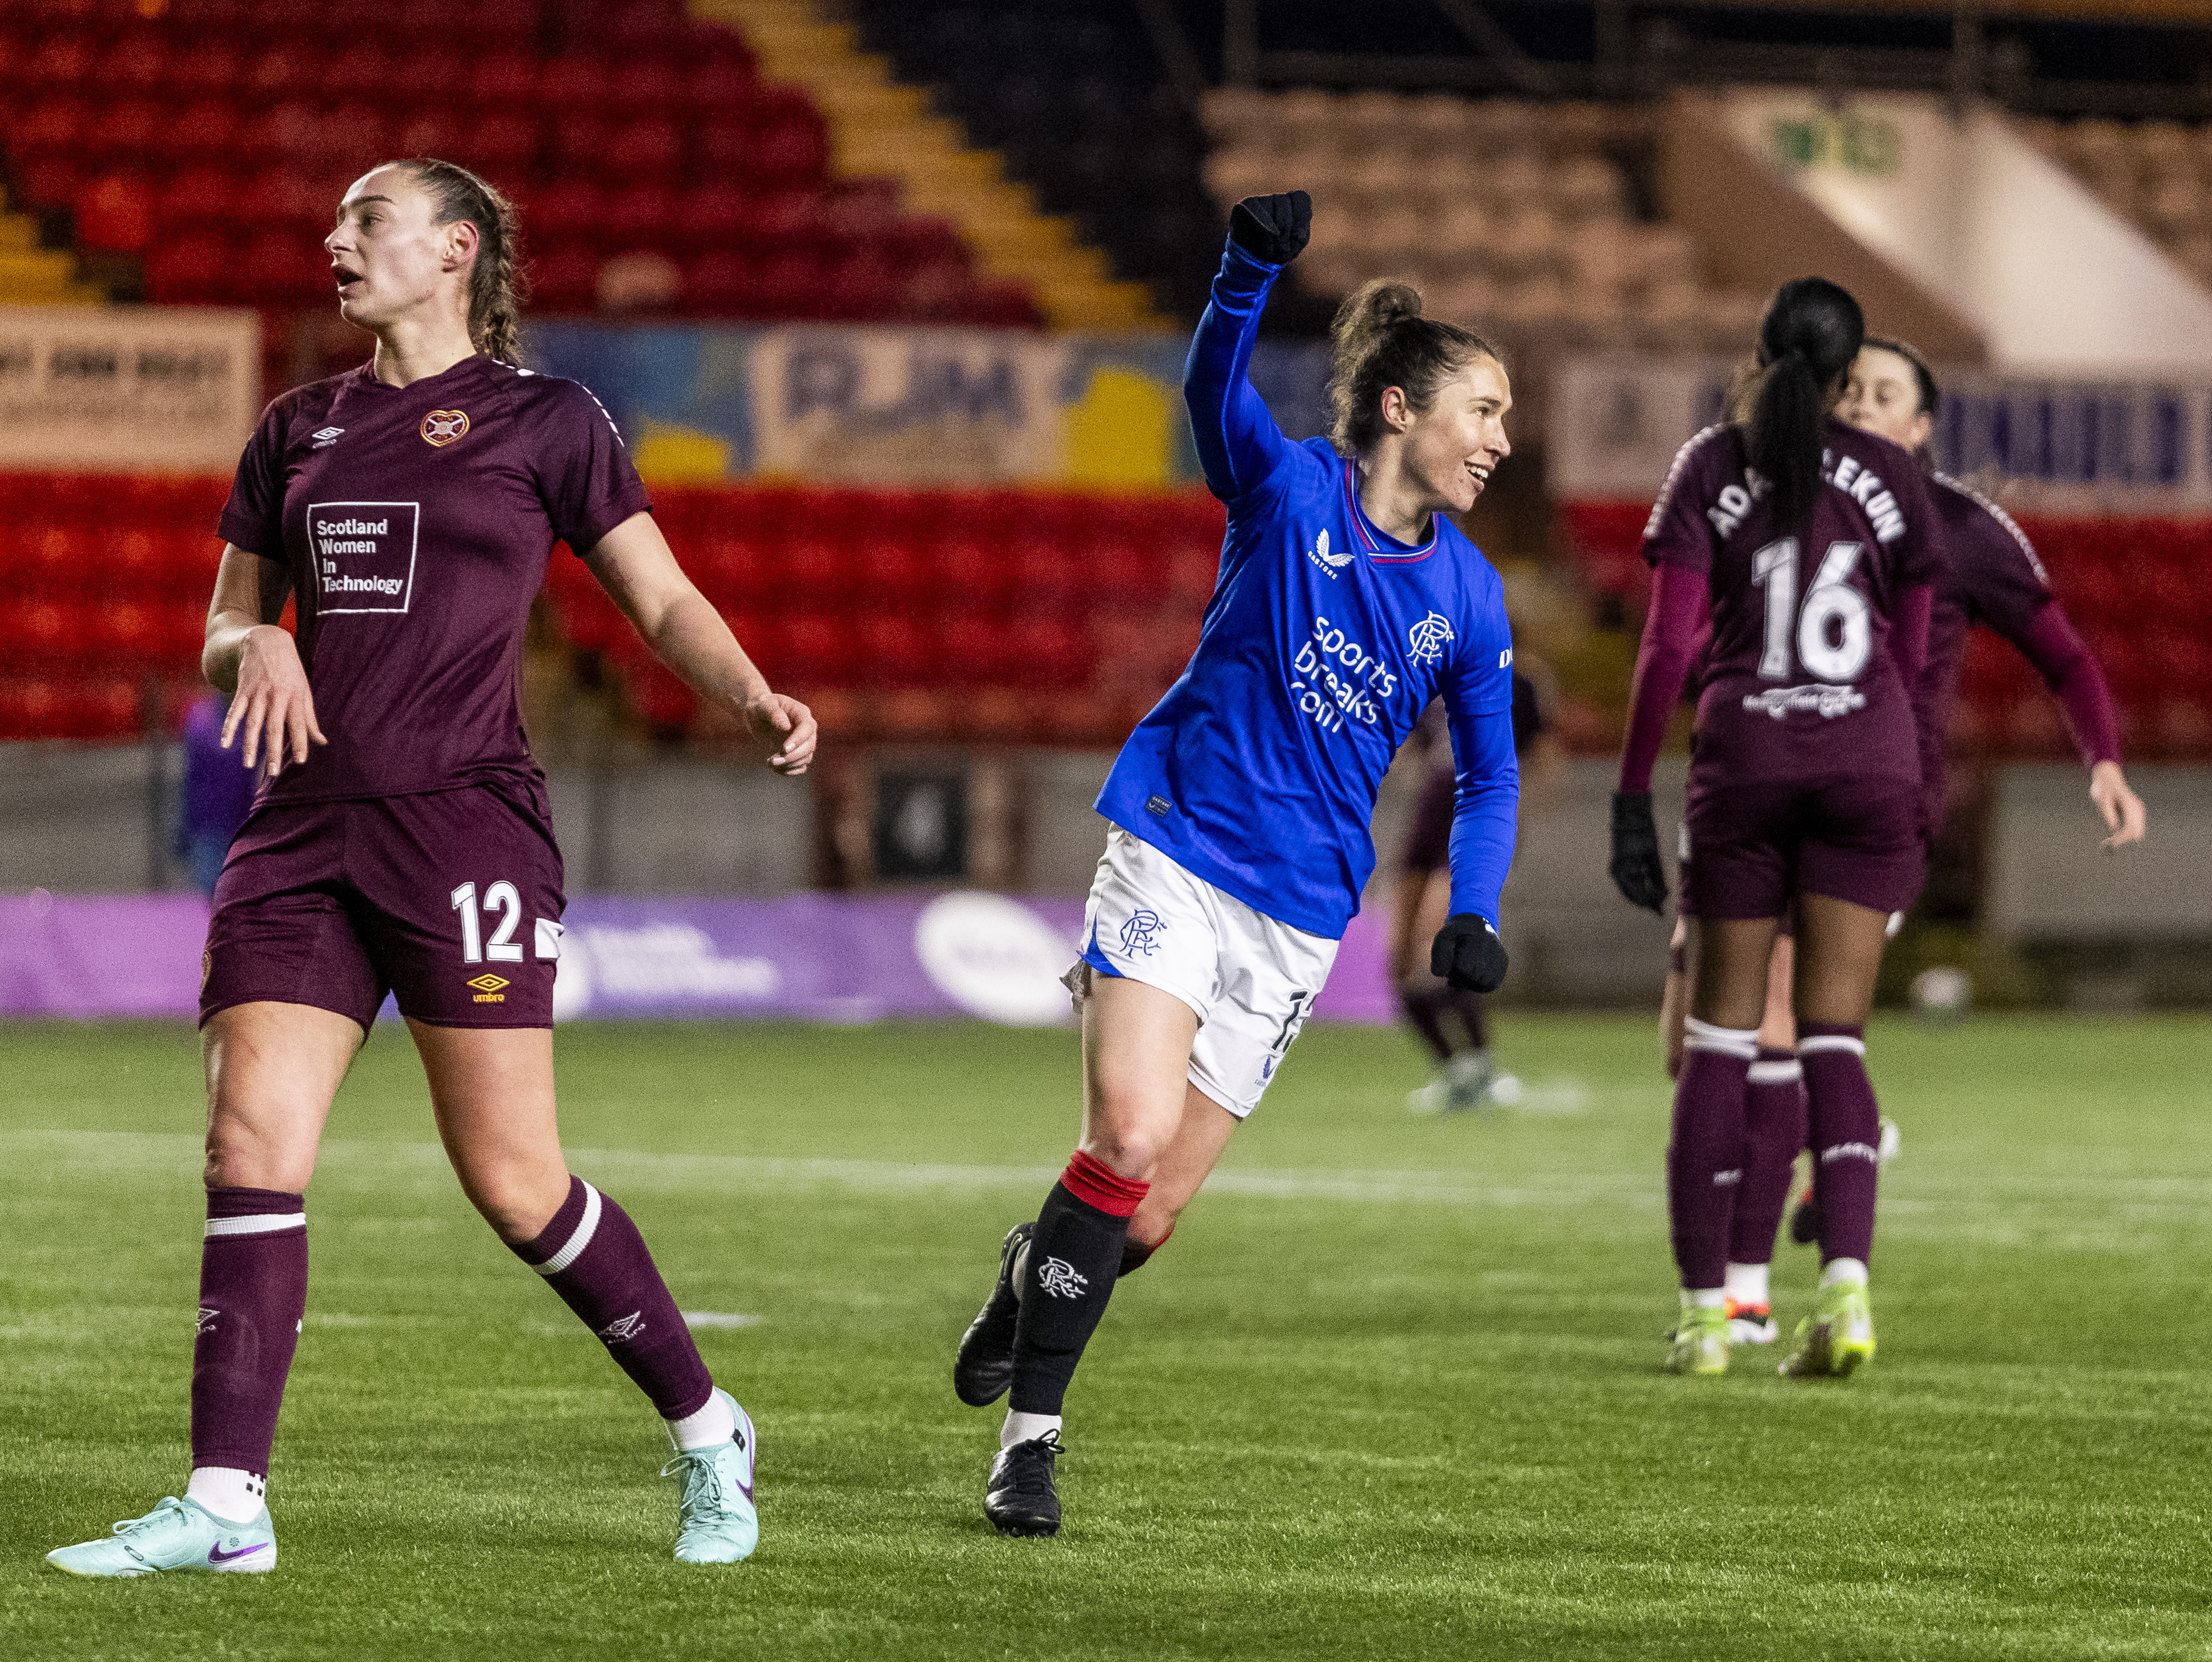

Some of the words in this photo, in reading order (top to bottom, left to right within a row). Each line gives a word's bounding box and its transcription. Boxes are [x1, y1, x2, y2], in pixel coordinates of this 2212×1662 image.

[317, 519, 388, 535] Scotland
[318, 538, 376, 555] Women
[323, 558, 336, 574] In
[1308, 551, 1338, 579] CASTORE
[322, 575, 403, 595] Technology
[1752, 536, 1873, 684] 16
[1312, 616, 1397, 698] sports
[1294, 640, 1381, 724] breaks
[451, 880, 523, 963] 12
[472, 992, 505, 1002] umbro
